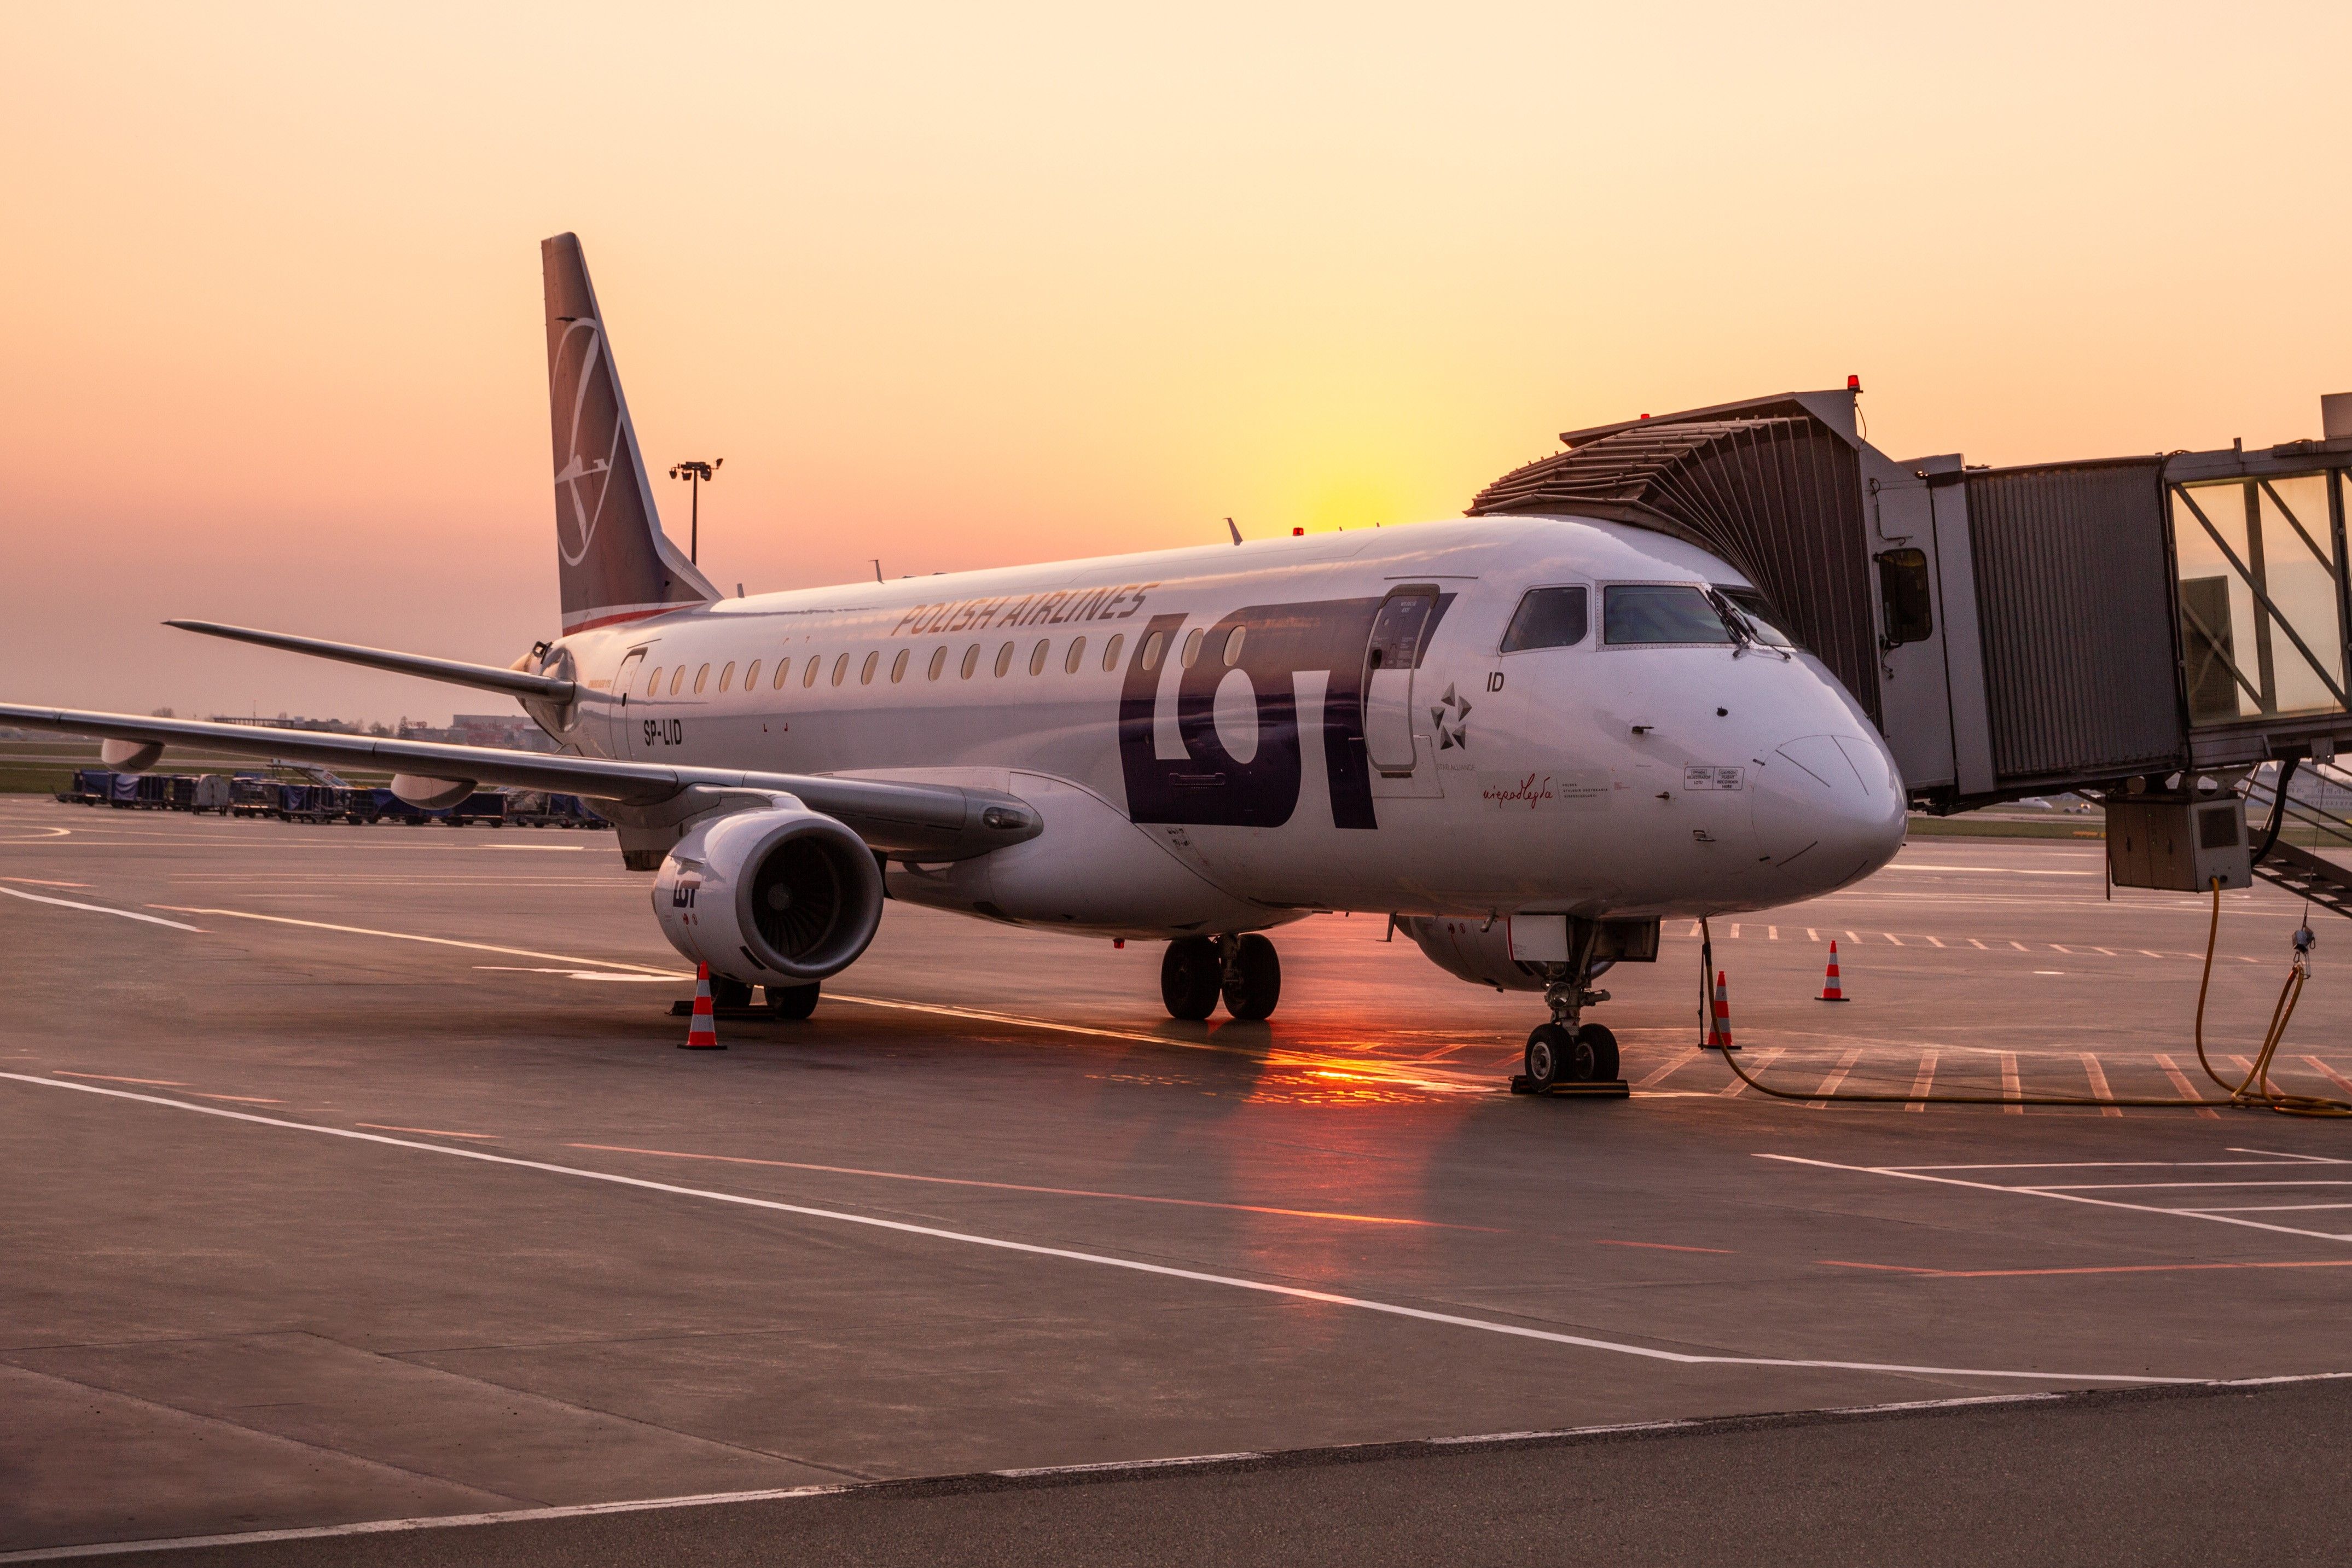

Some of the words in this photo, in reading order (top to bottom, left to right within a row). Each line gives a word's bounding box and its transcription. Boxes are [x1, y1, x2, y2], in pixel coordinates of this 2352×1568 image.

[891, 596, 1011, 636] POLISH
[996, 582, 1162, 629] AIRLINES
[1486, 672, 1505, 692] ID
[1118, 592, 1458, 830] LOT
[643, 719, 682, 746] SP-LID
[672, 880, 701, 908] LOT
